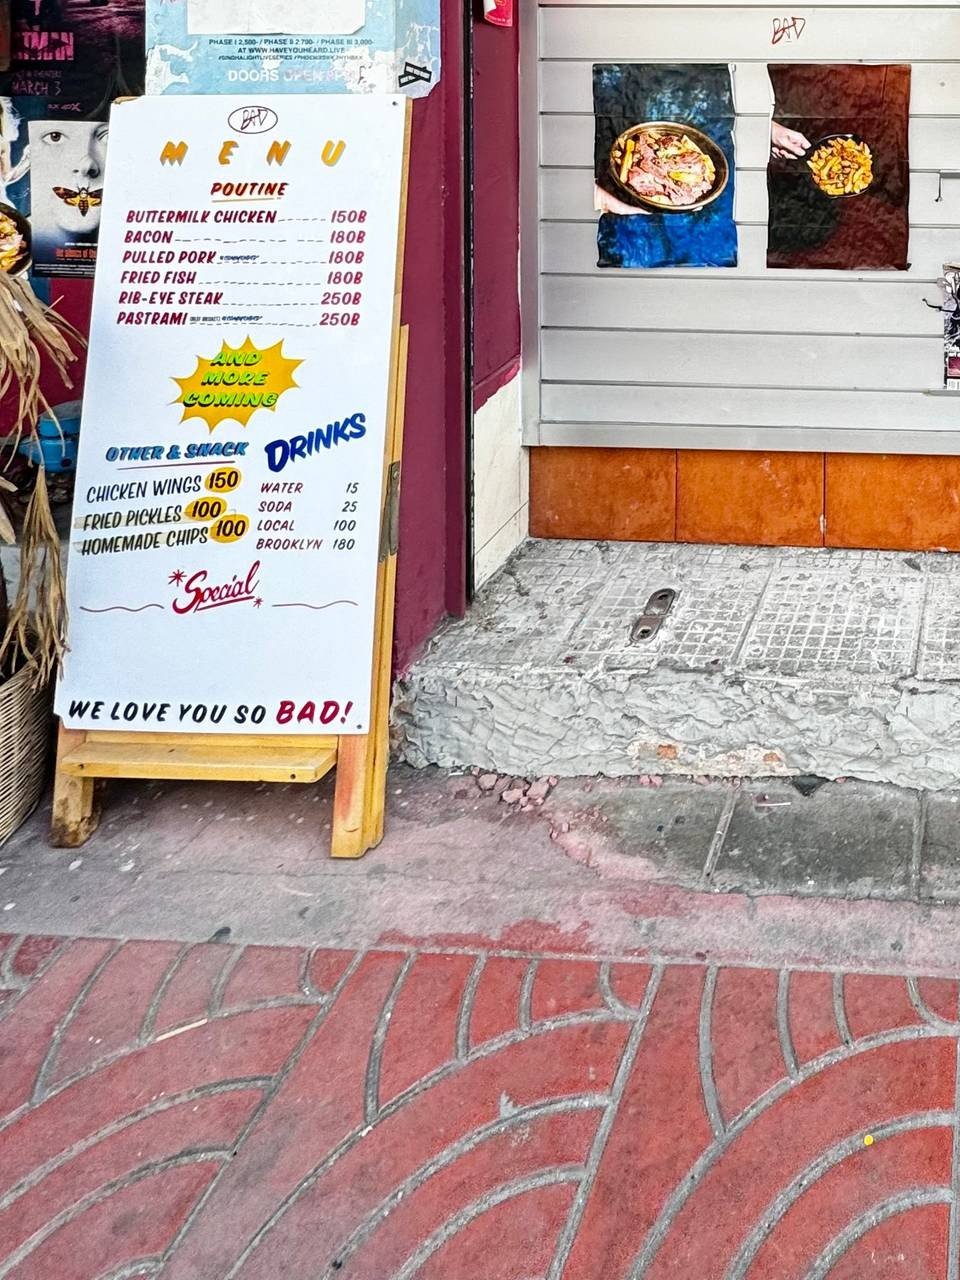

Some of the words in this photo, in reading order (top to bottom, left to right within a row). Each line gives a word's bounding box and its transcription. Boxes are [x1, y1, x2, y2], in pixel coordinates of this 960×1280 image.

[771, 16, 807, 45] BAD
[208, 38, 233, 46] PHASE
[264, 38, 288, 46] PHASE
[320, 38, 345, 46] PHASE
[228, 69, 279, 82] DOORS
[240, 107, 270, 131] BAD
[210, 181, 289, 198] POUTINE
[126, 209, 211, 225] BUTTERMILK
[213, 209, 278, 225] CHICKEN
[331, 209, 367, 224] 150B
[124, 230, 174, 245] BACON
[329, 230, 366, 245] 180B
[122, 250, 176, 265] PULLED
[177, 250, 217, 265] PORK
[328, 250, 364, 265] 180B
[120, 271, 161, 285] FRIED
[163, 271, 197, 285] FISH
[326, 271, 363, 285] 180B
[118, 291, 175, 305] RIB-EYE
[178, 291, 224, 305] STEAK
[320, 291, 362, 306] 250B
[116, 311, 188, 326] PASTRAMI
[319, 312, 360, 327] 250B
[209, 351, 263, 367] AND
[200, 371, 270, 386] MORE
[182, 391, 279, 408] COMING
[264, 412, 367, 473] DRINKS
[105, 444, 164, 462] OTHER
[166, 444, 182, 460] &
[184, 441, 249, 458] SNACK
[86, 481, 147, 504] CHICKEN
[152, 475, 202, 498] WINGS
[208, 470, 239, 490] 150
[260, 482, 304, 495] WATER
[345, 482, 359, 494] 15
[258, 501, 293, 513] SODA
[341, 501, 358, 513] 25
[83, 514, 122, 532] FRIED
[125, 505, 182, 526] PICKLES
[190, 501, 222, 519] 100
[257, 519, 295, 532] LOCAL
[333, 519, 356, 532] 100
[81, 532, 161, 557] HOMEMADE
[166, 526, 209, 548] CHIPS
[215, 519, 247, 538] 100
[255, 538, 322, 551] BROOKLYN
[332, 538, 355, 551] 180
[171, 560, 261, 614] Special
[67, 700, 105, 721] WE
[109, 701, 171, 722] LOVE
[178, 703, 228, 724] YOU
[234, 705, 267, 724] SO
[275, 700, 354, 725] BAD!
